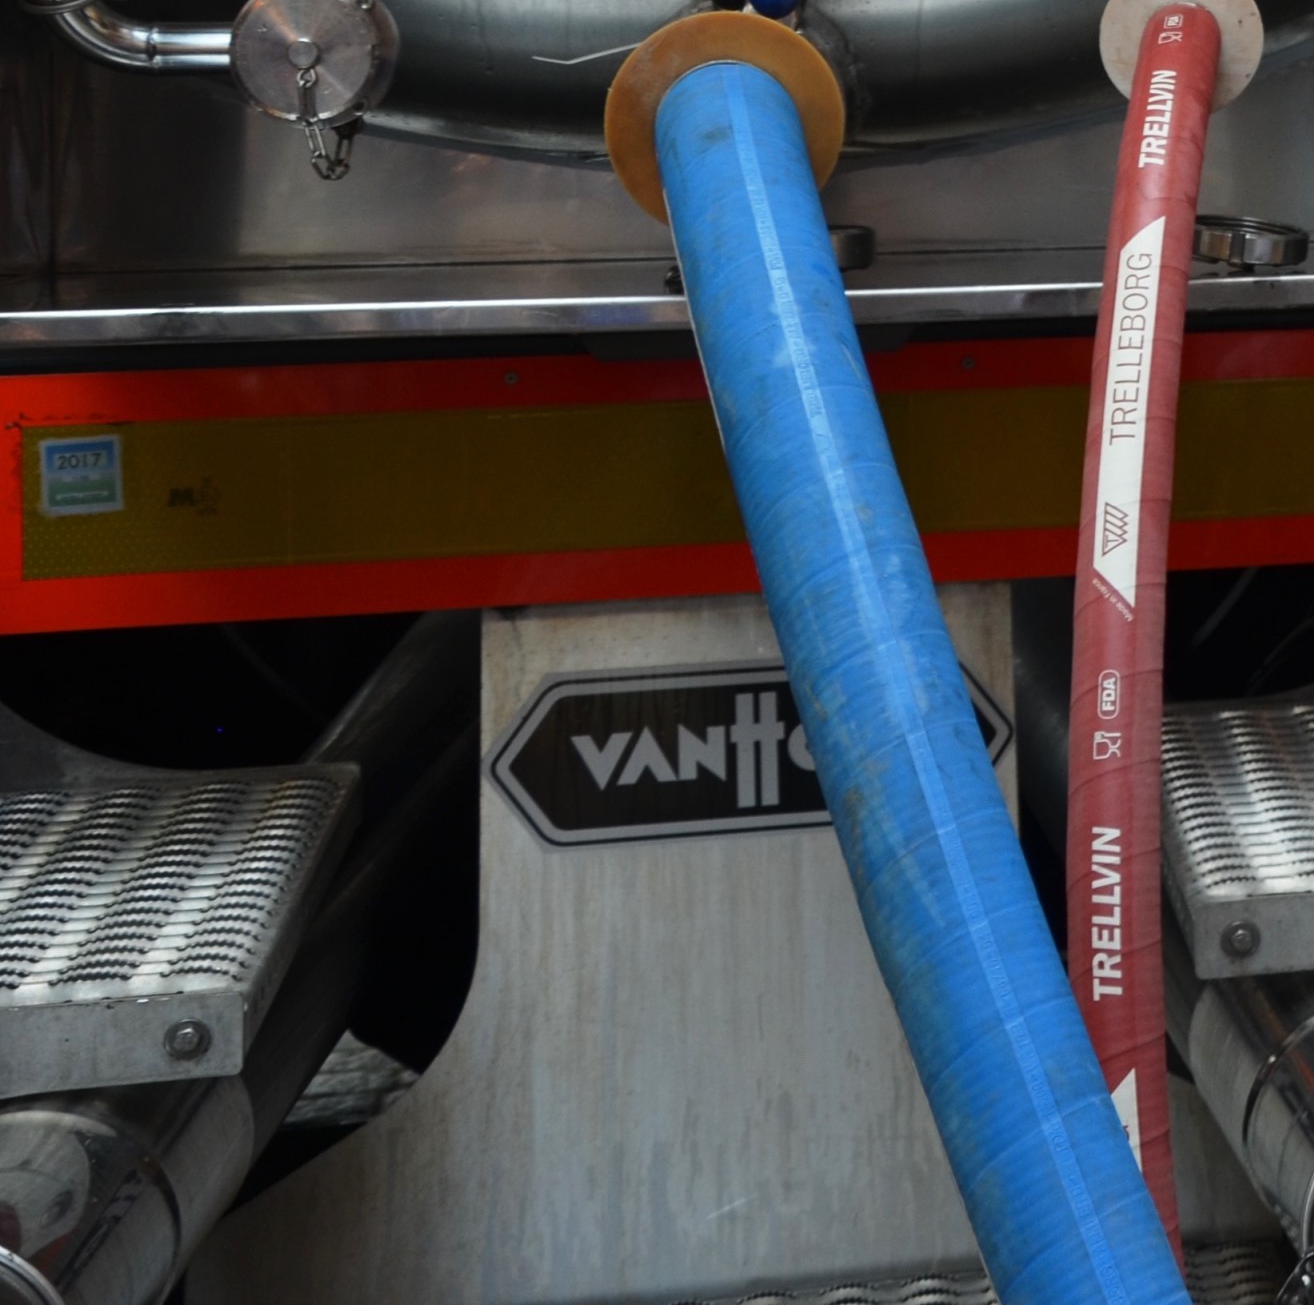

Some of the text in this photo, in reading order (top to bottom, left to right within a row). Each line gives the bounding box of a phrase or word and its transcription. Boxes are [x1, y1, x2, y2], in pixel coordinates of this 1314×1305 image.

[1138, 69, 1178, 168] TRELLVIN
[1109, 252, 1153, 446] TRELLEBORG
[56, 452, 101, 471] 2017
[1101, 676, 1117, 713] FDA
[1091, 826, 1123, 1002] TRELLVIN
